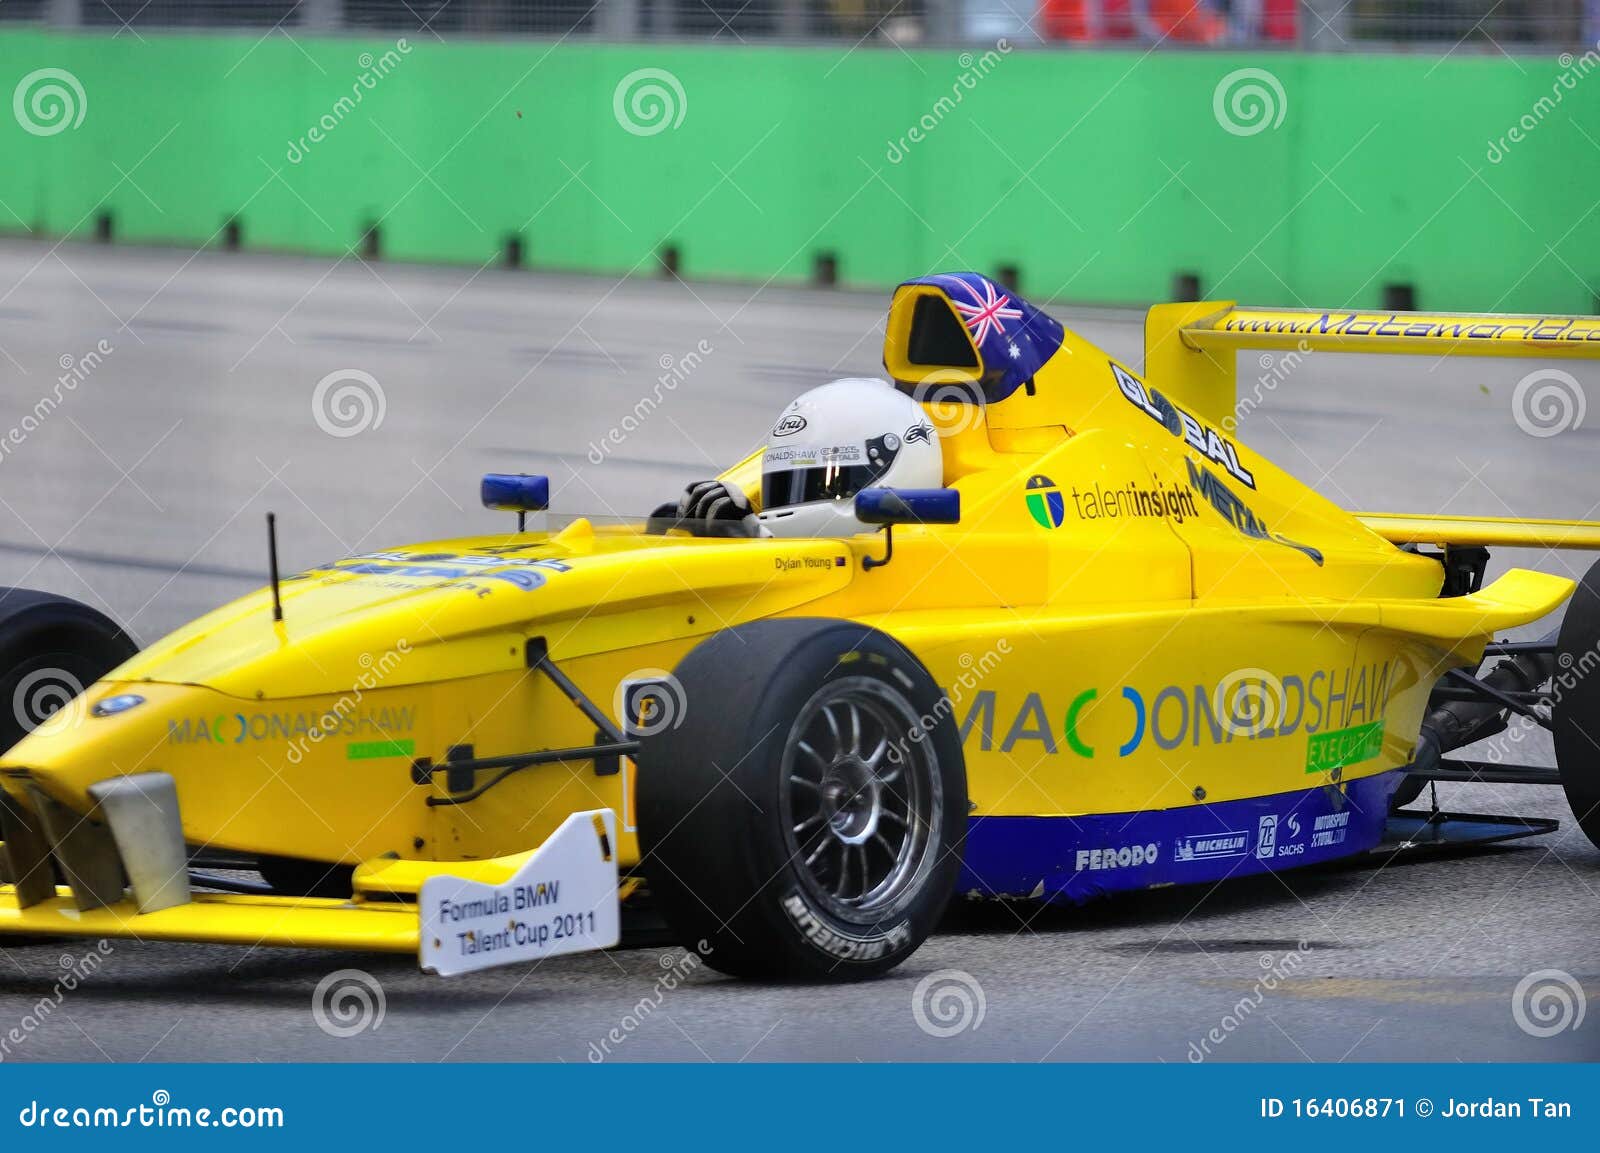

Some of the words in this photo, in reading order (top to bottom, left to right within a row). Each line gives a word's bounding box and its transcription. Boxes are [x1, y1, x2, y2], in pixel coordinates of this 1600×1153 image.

[1109, 361, 1257, 490] GLOBAL
[1072, 473, 1200, 524] talentinsight
[775, 557, 801, 571] Dylan
[804, 557, 831, 570] Young
[1075, 843, 1160, 870] FERODO
[1194, 836, 1246, 852] MICHELIN
[1278, 843, 1305, 856] SACHS
[439, 891, 509, 923] Formula
[514, 880, 560, 910] BMW
[457, 929, 510, 955] Talent
[514, 921, 549, 946] Cup
[553, 911, 596, 939] 2011
